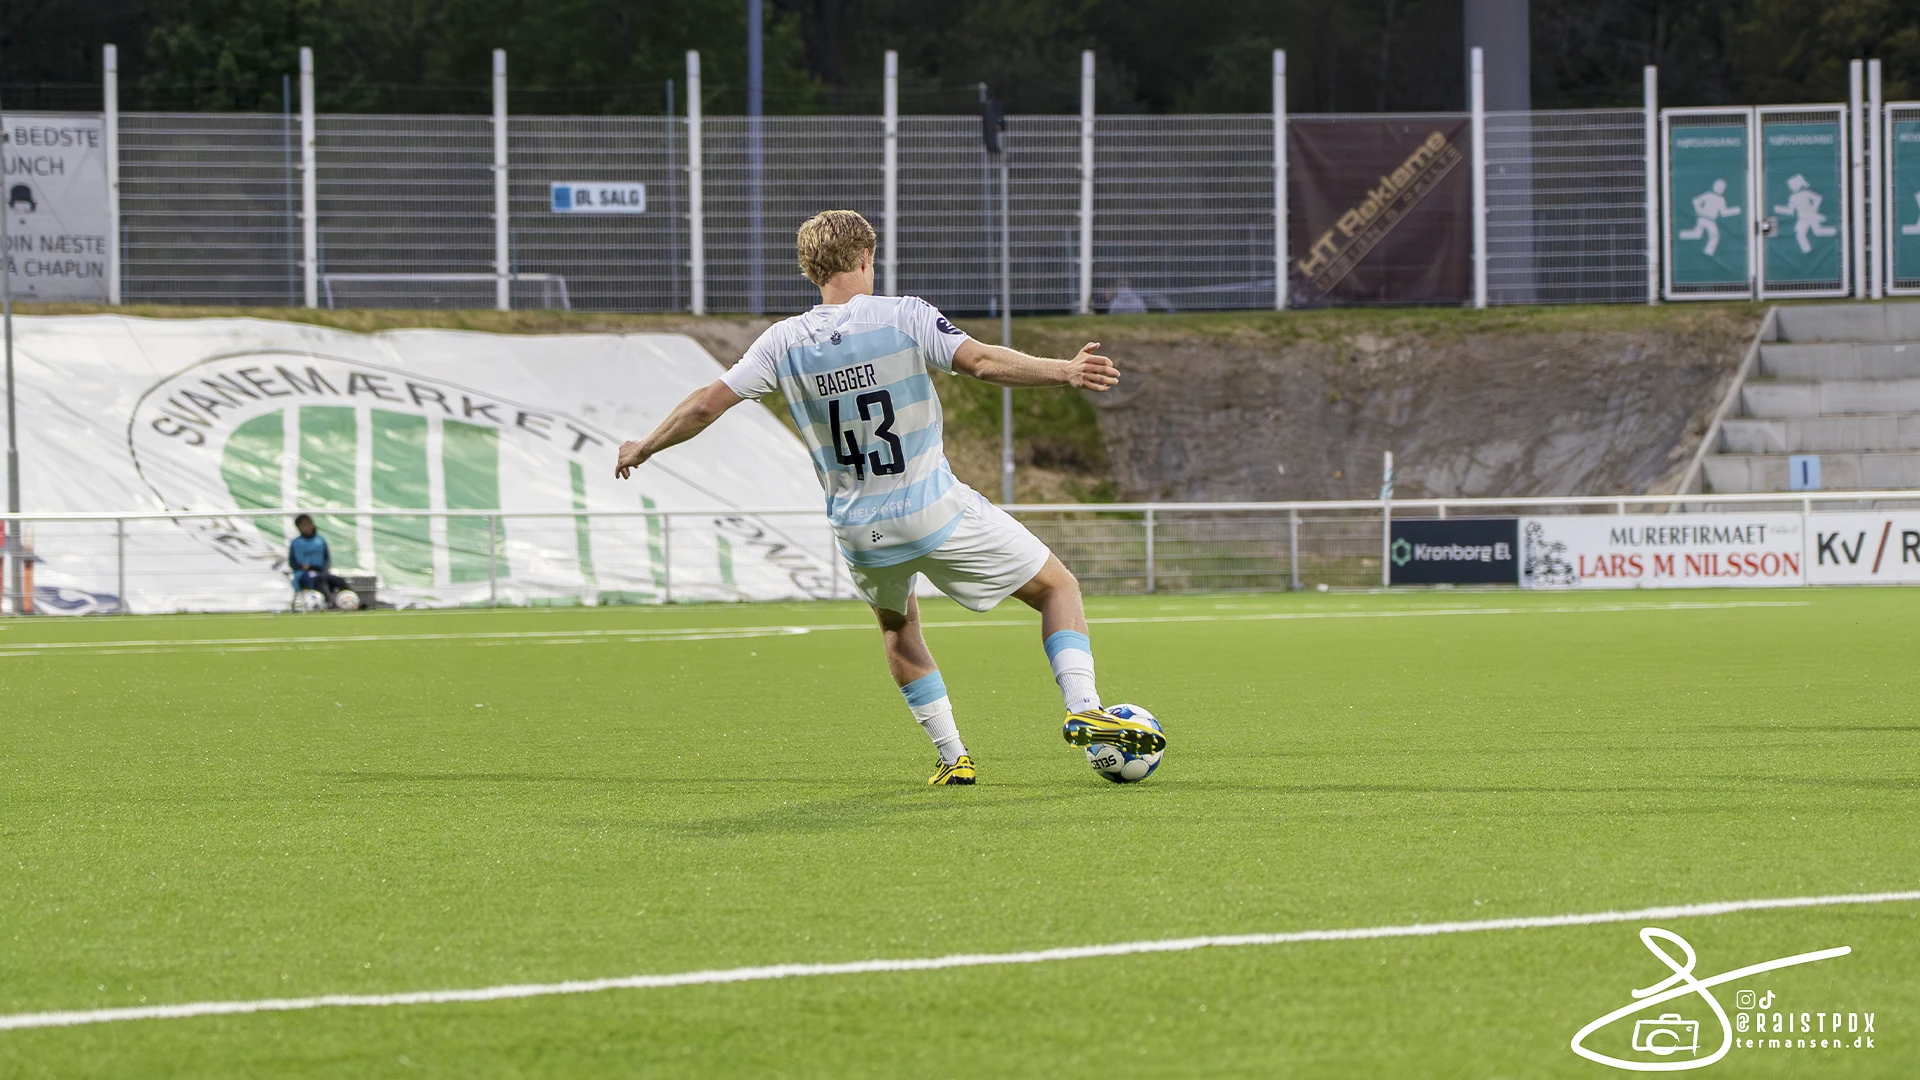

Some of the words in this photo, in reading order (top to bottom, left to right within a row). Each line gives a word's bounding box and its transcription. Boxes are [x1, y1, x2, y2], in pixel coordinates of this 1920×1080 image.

[15, 126, 100, 148] BEDSTE
[1298, 230, 1338, 278] HT
[1335, 131, 1447, 237] Reklame
[40, 234, 106, 254] NÆSTE
[24, 259, 104, 278] CHAPLIN
[815, 363, 878, 397] BAGGER
[152, 364, 603, 453] SVANEMÆRKET
[828, 389, 906, 481] 43
[1609, 523, 1767, 547] MURERFIRMAET
[1414, 543, 1492, 562] Kronborg
[1578, 553, 1645, 579] LARS
[1653, 554, 1677, 579] M
[1684, 551, 1800, 578] NILSSON
